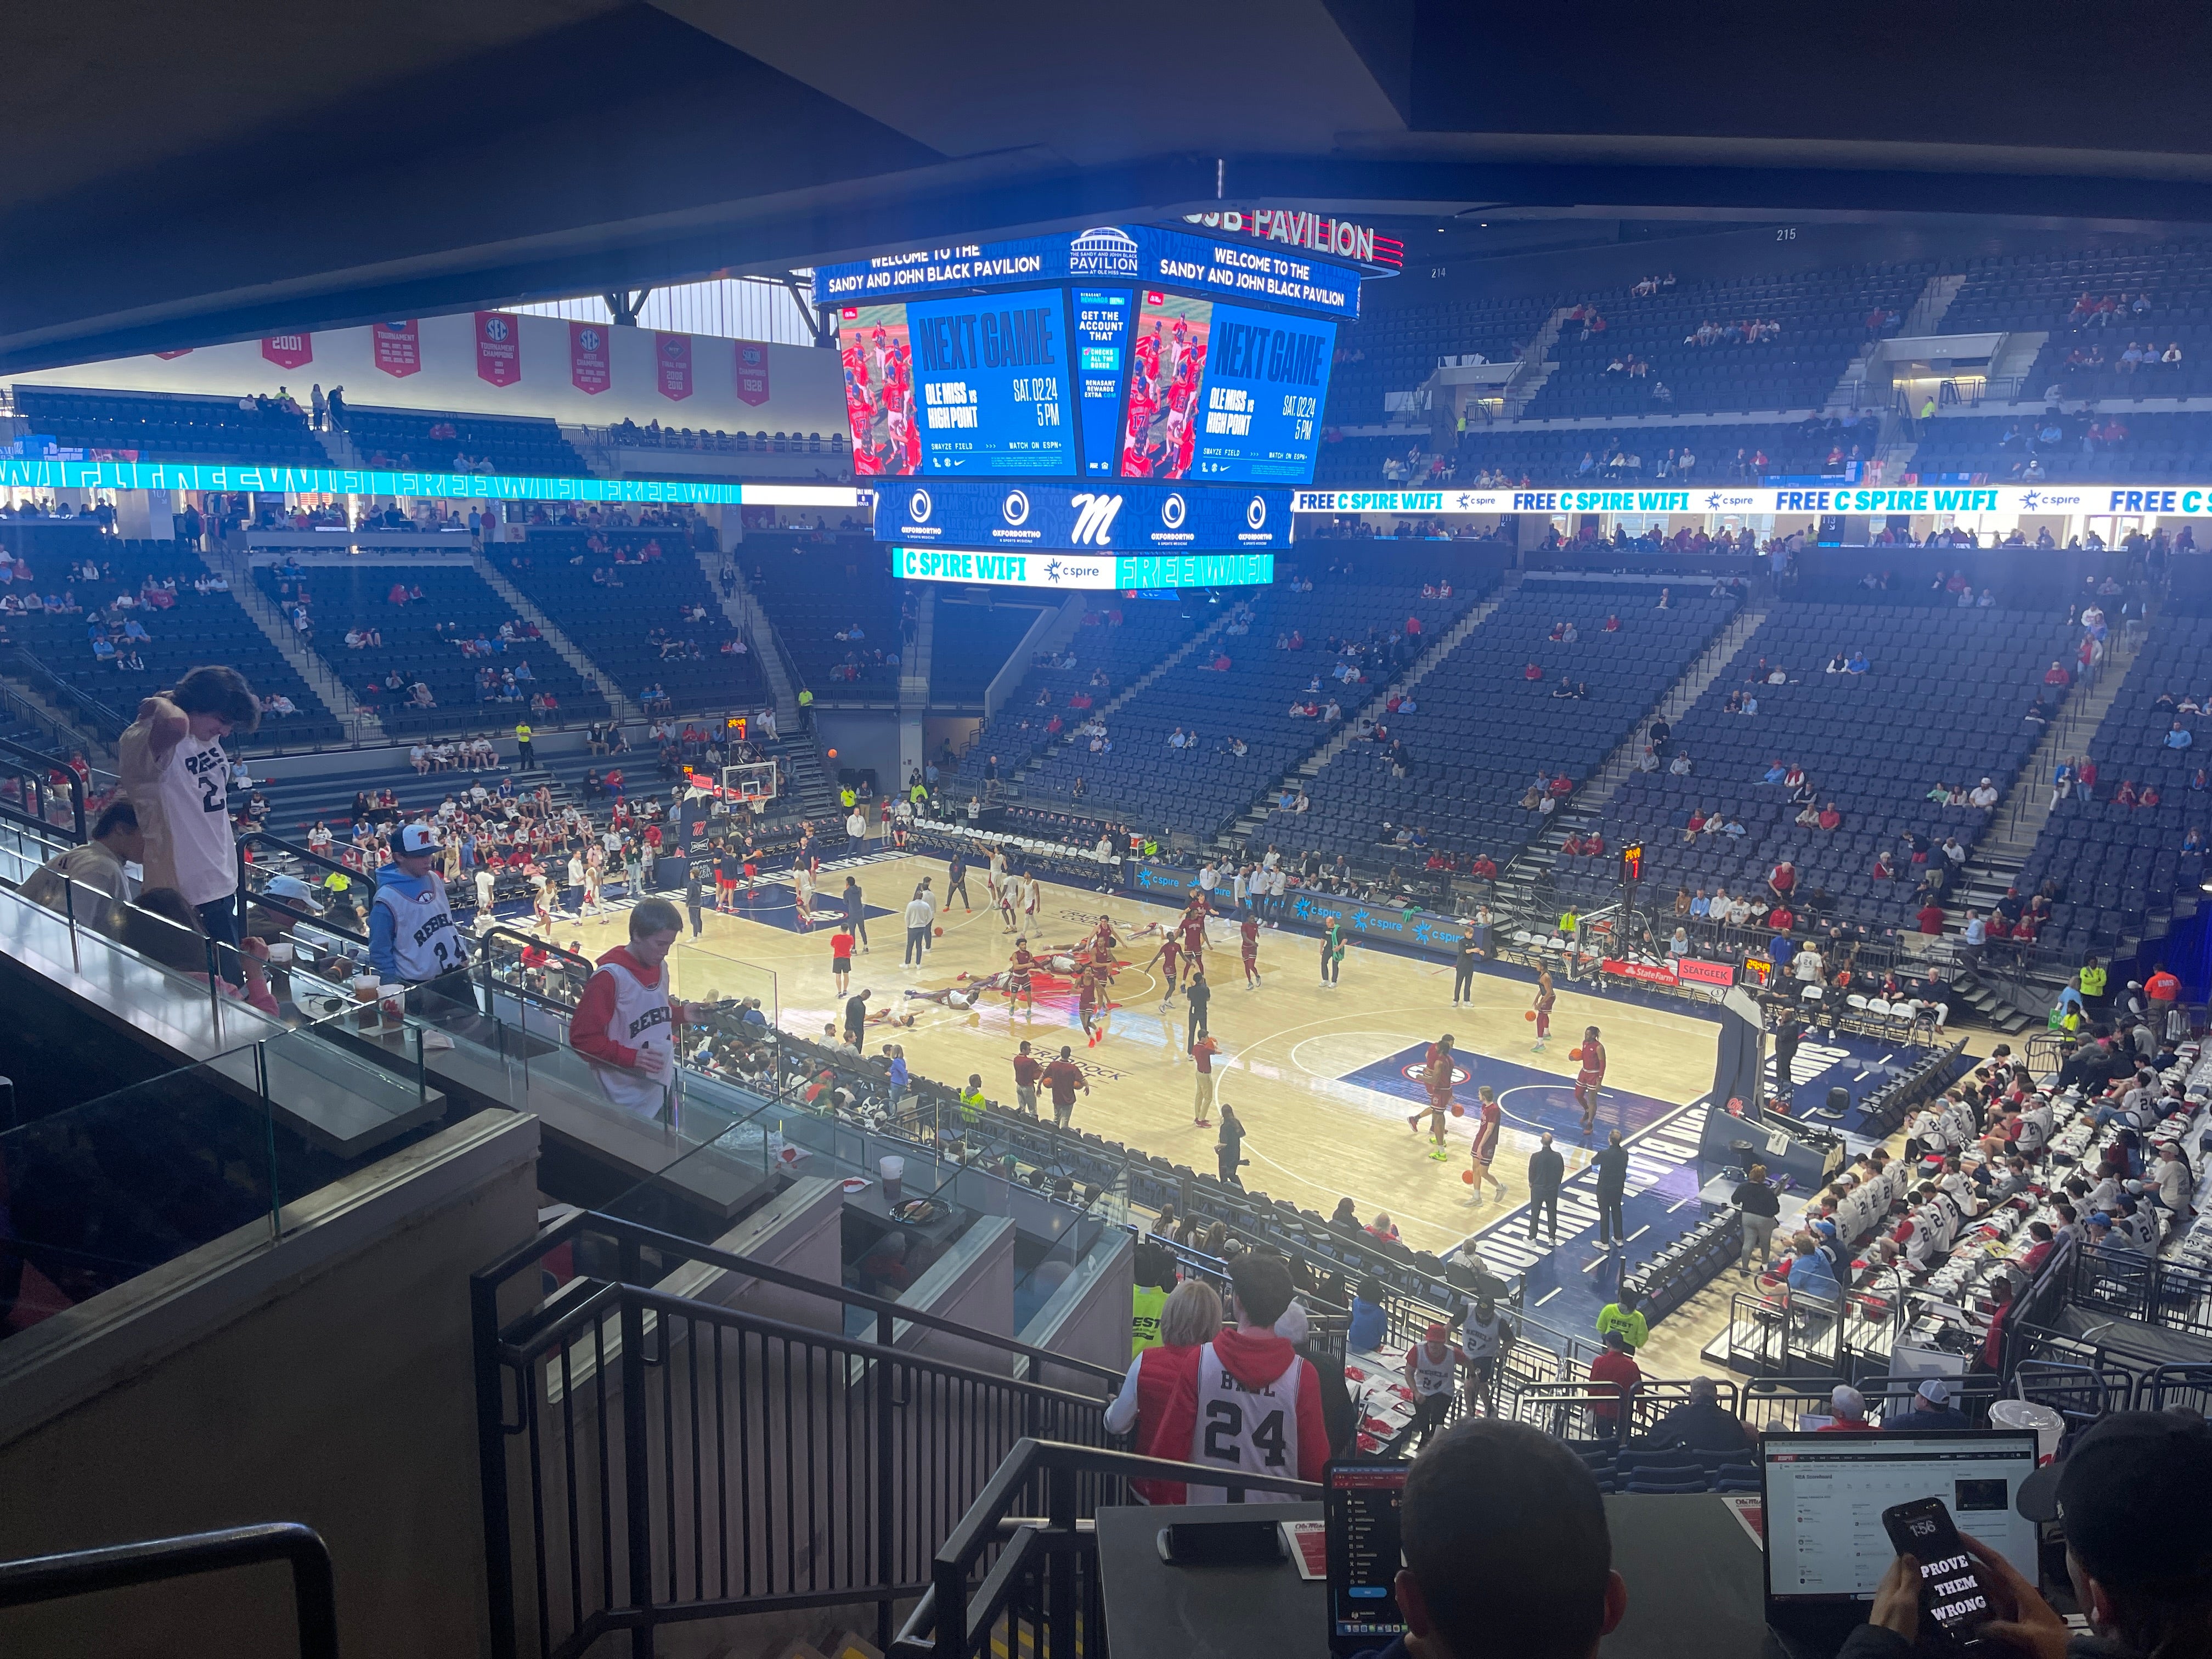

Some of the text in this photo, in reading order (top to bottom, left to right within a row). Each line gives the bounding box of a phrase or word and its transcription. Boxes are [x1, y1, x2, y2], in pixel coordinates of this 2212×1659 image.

[1251, 210, 1374, 262] PAVILION
[1776, 228, 1796, 241] 215
[871, 251, 928, 268] WELCOME
[1070, 257, 1138, 271] PAVILION
[1215, 247, 1310, 280] WELCOME TO THE
[829, 256, 1040, 293] SANDY AND JOHN BLACK PAVILION
[1431, 268, 1446, 278] 214
[1160, 258, 1344, 307] SANDY AND JOHN BLACK PAVILION
[1081, 311, 1119, 321] GET THE
[487, 319, 506, 341] SEC
[1079, 321, 1124, 331] ACCOUNT
[272, 336, 302, 351] 2001
[377, 331, 415, 341] TOURNAMENT
[581, 330, 599, 351] SEC
[918, 307, 1054, 371] NEXT GAME
[1090, 331, 1113, 341] THAT
[480, 342, 515, 352] TOURNAMENT
[483, 351, 513, 359] CHAMPIONS
[1214, 321, 1325, 386] NEXT GAME
[577, 359, 605, 368] CHAMPIONS
[667, 371, 683, 381] 2008
[739, 368, 766, 377] CHAMPIONS
[668, 381, 683, 390] 2010
[744, 379, 762, 392] 1928
[925, 381, 967, 405] OLE MISS
[1013, 377, 1058, 402] SAT. 02.24
[1209, 387, 1248, 413] OLE MISS
[1283, 395, 1317, 418] SAT. 02.24
[927, 406, 978, 429] HIGH POINT
[1037, 403, 1060, 426] 5 PM
[1133, 415, 1145, 430] 17
[1206, 412, 1252, 436] HIGH POINT
[1295, 420, 1313, 441] 5 PM
[1203, 448, 1222, 456] SWAYZE
[393, 472, 678, 503] FREE WIFI FREE
[1299, 494, 1335, 509] FREE
[1338, 493, 1348, 509] C
[1351, 493, 1398, 509] SPIRE
[1402, 493, 1443, 510] WIFI
[1476, 496, 1496, 506] spire
[1513, 493, 1556, 510] FREE
[1560, 493, 1572, 510] C
[1576, 493, 1634, 510] SPIRE
[1638, 492, 1690, 510] WIFI
[1729, 496, 1753, 506] spire
[1776, 492, 1830, 510] FREE
[1835, 491, 1850, 510] C
[1854, 491, 1927, 510] SPIRE
[1934, 490, 1999, 511] WIFI
[2051, 494, 2080, 507] spire
[2109, 490, 2176, 512] FREE
[2182, 490, 2202, 513] C
[1071, 492, 1124, 546] M
[901, 527, 942, 535] OXFORDORTHO
[992, 529, 1041, 538] OXFORDORTHO
[906, 551, 1267, 588] C SPIRE WIFI spire FREE WIFI
[692, 820, 707, 837] M
[1158, 877, 1179, 887] spire
[1215, 887, 1231, 898] pire
[1318, 909, 1342, 919] spire
[1369, 918, 1376, 926] c
[1377, 919, 1402, 932] spire
[1432, 930, 1438, 939] c
[1683, 965, 1728, 980] SEATGEEK
[1746, 959, 1770, 973] 29:49
[1636, 968, 1673, 983] State Farm
[1758, 970, 1765, 984] 7
[2158, 979, 2175, 988] EMS
[1132, 1317, 1161, 1329] EST
[1610, 1319, 1633, 1328] BEST
[1466, 1329, 1492, 1341] REBELS
[1419, 1369, 1448, 1378] REBELS
[1221, 1370, 1275, 1397] BL
[1204, 1400, 1286, 1466] 24
[1910, 1520, 1936, 1537] 1:56
[1920, 1555, 1969, 1578] PROVE
[1934, 1575, 1978, 1597] THEM
[1931, 1595, 1987, 1621] WRONG
